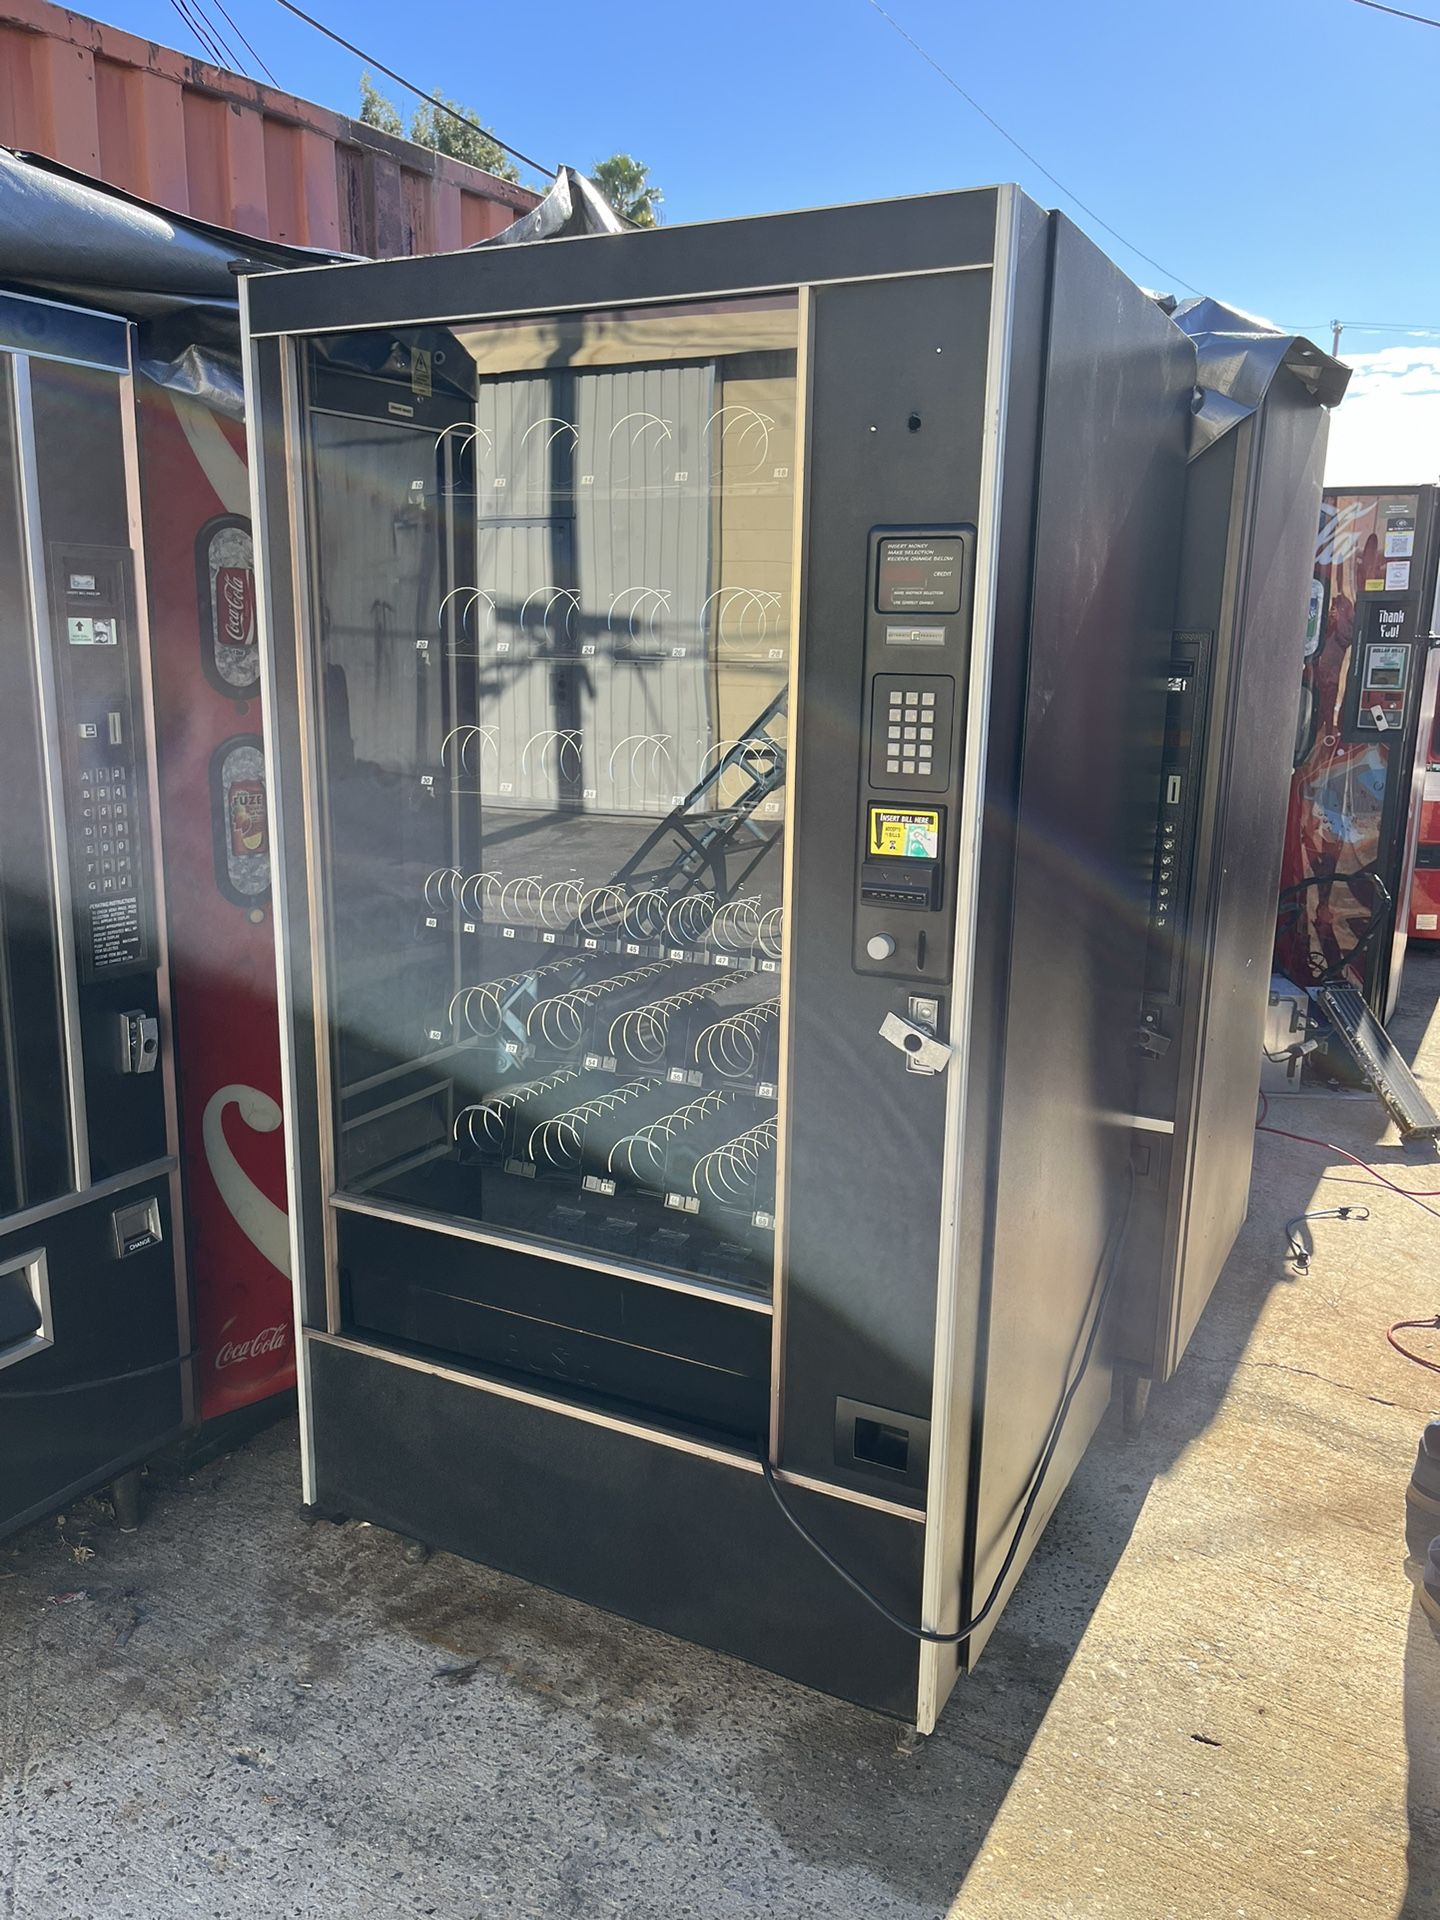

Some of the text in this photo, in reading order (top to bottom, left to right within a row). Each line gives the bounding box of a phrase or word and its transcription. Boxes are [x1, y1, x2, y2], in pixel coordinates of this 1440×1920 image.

[224, 573, 244, 641] Coca-Cola
[1378, 609, 1405, 623] Thank
[1380, 624, 1400, 638] You!
[81, 772, 89, 780] A
[114, 769, 120, 777] 2
[83, 790, 90, 798] B
[116, 787, 121, 796] 4
[233, 795, 262, 806] FUZE
[83, 808, 91, 817] C
[116, 805, 122, 813] 6
[880, 813, 900, 822] INSERT
[85, 827, 92, 835] D
[102, 825, 107, 834] 7
[86, 841, 124, 854] E 9 0
[88, 877, 126, 890] G H J
[129, 1237, 151, 1251] CHANGE
[215, 1322, 288, 1370] Coca-Cola
